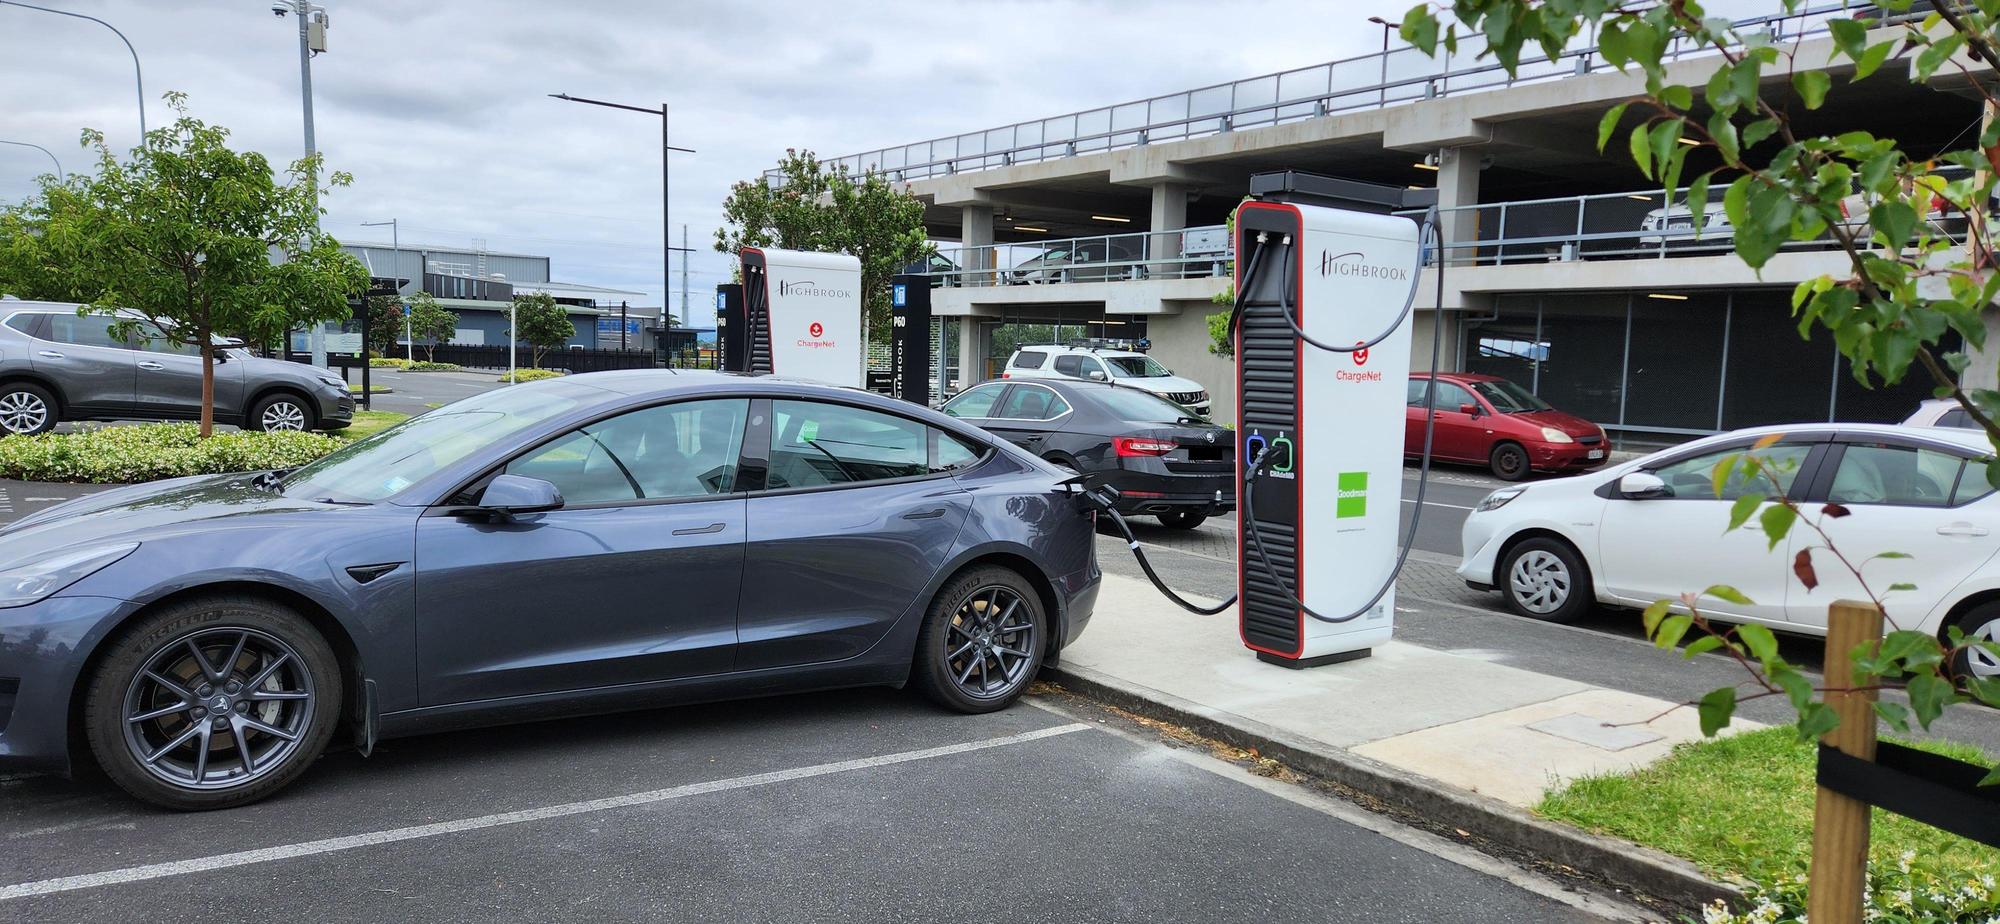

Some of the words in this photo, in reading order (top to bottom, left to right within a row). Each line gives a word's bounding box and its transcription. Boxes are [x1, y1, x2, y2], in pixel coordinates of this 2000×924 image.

[1317, 248, 1407, 281] HIGHBROOK
[777, 279, 851, 298] HIGHBROOK
[894, 316, 906, 327] P60
[797, 340, 835, 348] ChargeNet
[1336, 370, 1382, 383] ChargeNet
[1338, 489, 1367, 498] Goodman
[140, 611, 219, 650] MICHELIN
